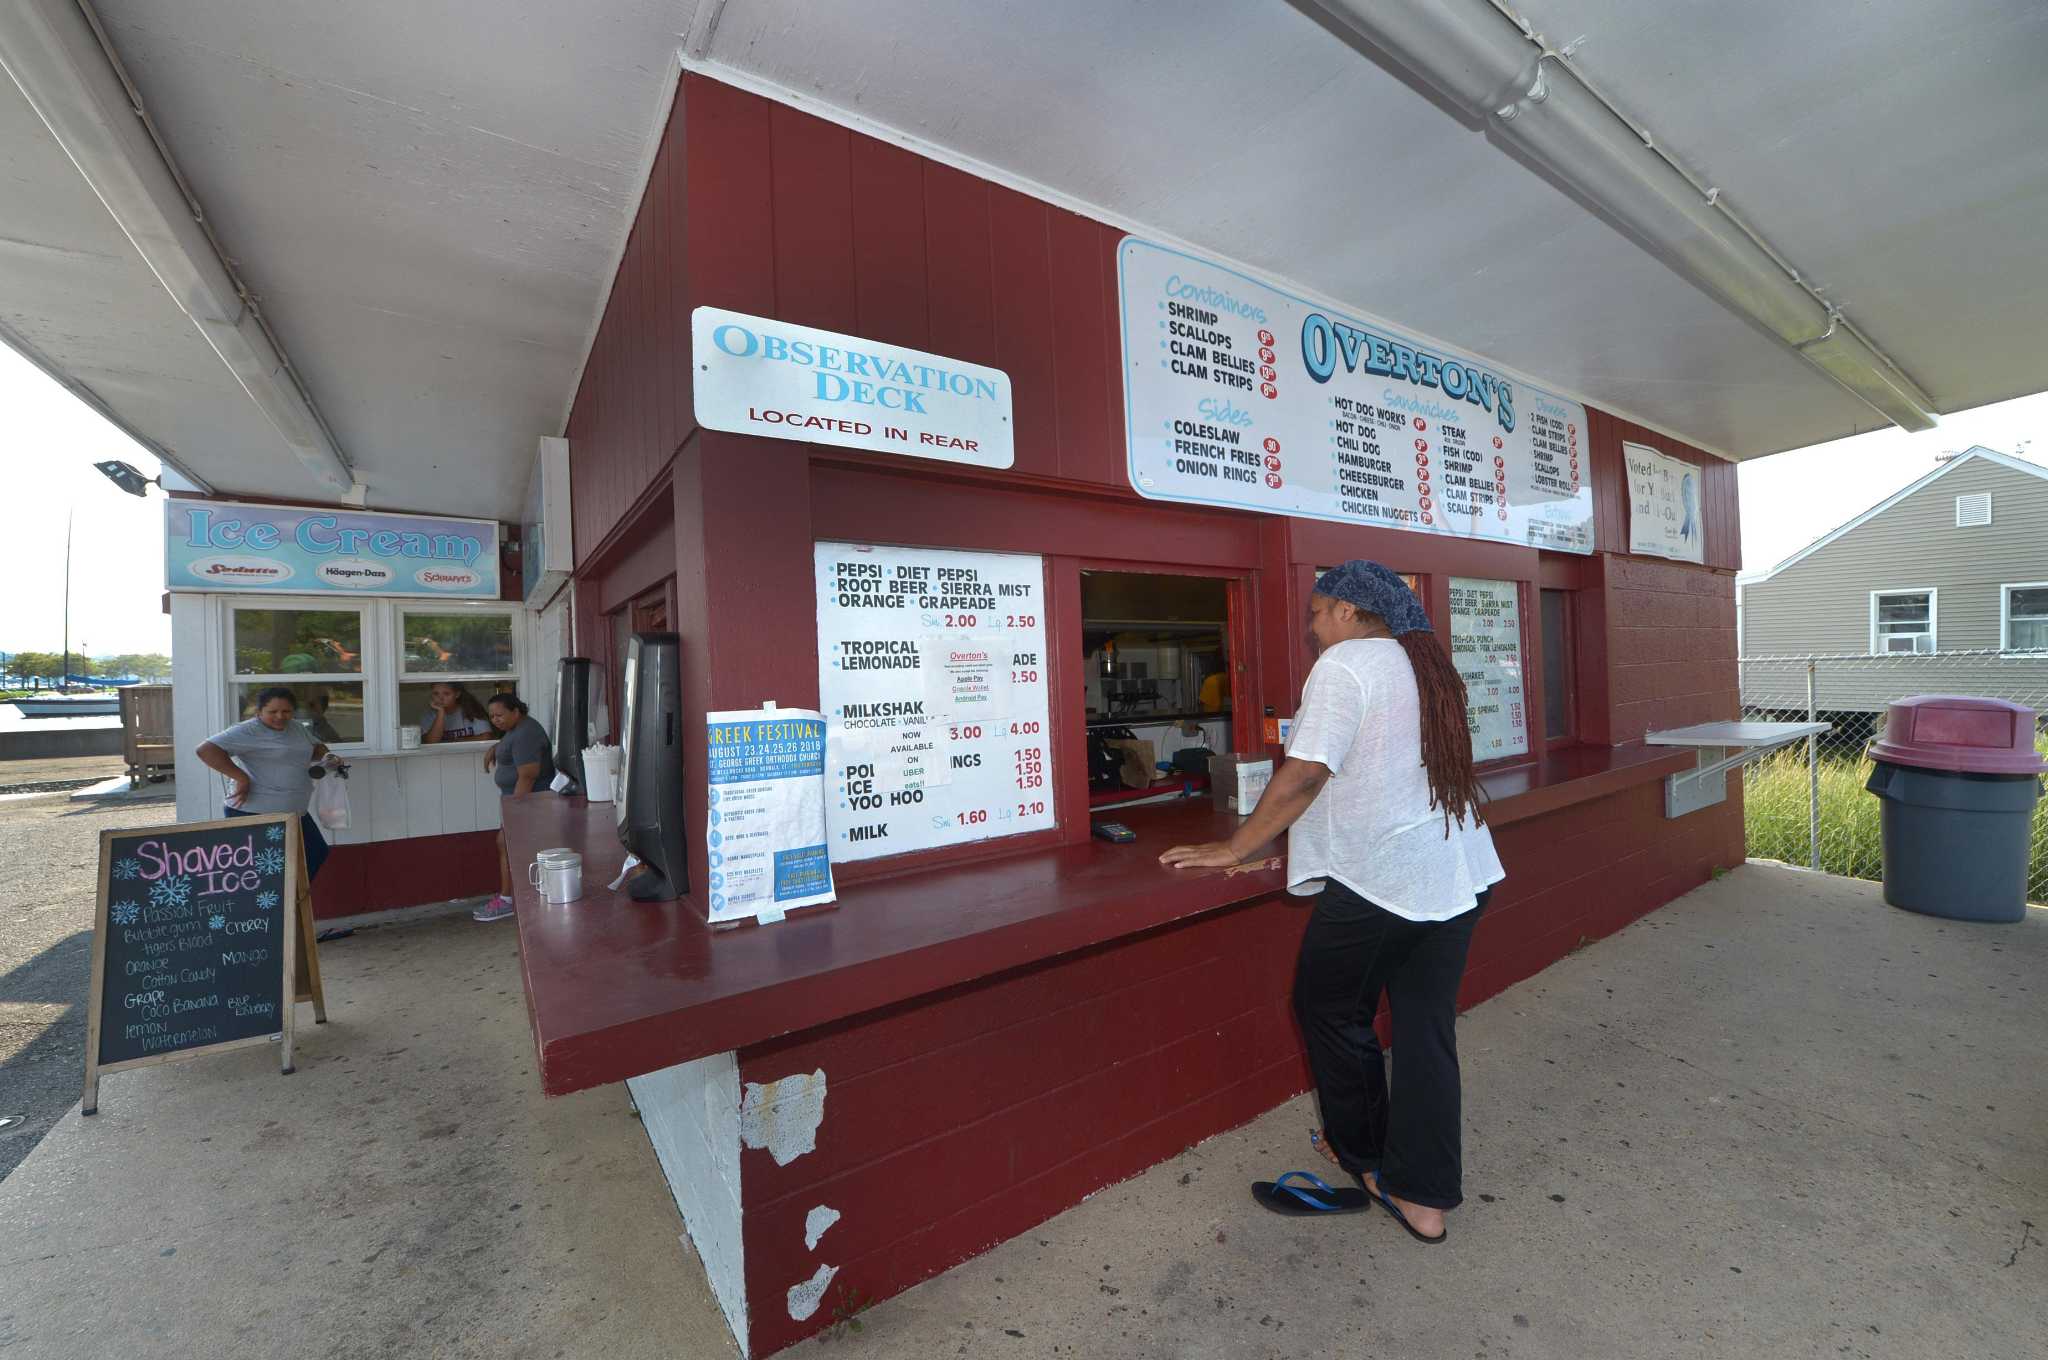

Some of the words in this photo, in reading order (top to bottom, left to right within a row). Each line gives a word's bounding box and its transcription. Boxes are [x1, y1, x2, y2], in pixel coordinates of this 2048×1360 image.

[1165, 275, 1267, 324] Containers
[1168, 302, 1218, 326] SHRIMP
[1169, 320, 1232, 349] SCALLOPS
[712, 325, 998, 400] OBSERVATION
[1170, 340, 1207, 361] CLAM
[1212, 350, 1255, 374] BELLIES
[1171, 360, 1208, 380] CLAM
[1213, 369, 1253, 391] STRIPS
[1302, 313, 1515, 433] OVERTON'S
[812, 371, 928, 414] DECK
[1198, 397, 1254, 427] Sides
[1335, 396, 1353, 411] HOT
[1356, 403, 1374, 417] DOG
[1377, 408, 1406, 425] WORKS
[749, 407, 871, 435] LOCATED
[884, 427, 908, 440] IN
[920, 432, 978, 452] REAR
[1174, 420, 1240, 444] COLESLAW
[1336, 420, 1354, 434] HOT
[1358, 425, 1376, 439] DOG
[1442, 425, 1466, 439] STEAK
[1532, 424, 1547, 437] CLAM
[1548, 430, 1565, 443] STRIPS
[1175, 439, 1225, 460] FRENCH
[1230, 448, 1261, 467] FRIES
[1337, 437, 1359, 451] CHILI
[1363, 441, 1380, 456] DOG
[1443, 446, 1460, 459] FISH
[1463, 449, 1483, 463] (COD)
[1533, 437, 1547, 449] CLAM
[1549, 442, 1567, 455] BELLIES
[1534, 449, 1553, 462] SHRIMP
[1176, 459, 1217, 478] ONION
[1223, 465, 1257, 483] RINGS
[1338, 452, 1391, 473] HAMBURGER
[1444, 460, 1473, 474] SHRIMP
[1535, 461, 1559, 476] SCALLOPS
[1628, 458, 1652, 476] Voted
[1339, 468, 1404, 491] CHEESEBURGER
[1445, 474, 1466, 487] CLAM
[1470, 479, 1494, 492] BELLIES
[1535, 473, 1557, 487] LOBSTER
[1559, 480, 1570, 491] ROLL
[1341, 484, 1378, 501] CHICKEN
[1446, 488, 1467, 500] CLAM
[1470, 492, 1494, 505] STRIPS
[1342, 501, 1379, 516] CHICKEN
[1382, 506, 1418, 522] NUGGETS
[1447, 502, 1483, 517] SCALLOPS
[186, 509, 281, 551] Ice
[295, 515, 481, 567] Cream
[837, 562, 882, 578] PEPSI
[897, 566, 930, 580] DIET
[937, 568, 978, 582] PEPSI
[837, 578, 882, 593] ROOT
[889, 580, 928, 594] BEER
[941, 583, 992, 596] SIERRA
[999, 584, 1031, 597] MIST
[838, 593, 905, 609] ORANGE
[919, 596, 996, 610] GRAPEADE
[945, 614, 976, 628] 2.00
[1006, 615, 1036, 628] 2.50
[841, 641, 918, 655] TROPICAL
[950, 651, 988, 660] Overton's
[841, 656, 920, 670] LEMONADE
[1011, 671, 1038, 684] 2.50
[843, 701, 924, 718] MILKSHAK
[843, 717, 896, 729] CHOCOLATE
[950, 726, 981, 740] 3.00
[1010, 721, 1040, 735] 4.00
[708, 725, 752, 744] GREEK
[758, 722, 820, 741] FESTIVAL
[902, 731, 920, 740] NOW
[709, 746, 740, 759] AUGUST
[801, 741, 820, 752] 2018
[890, 742, 934, 753] AVAILABLE
[1014, 748, 1041, 762] 1.50
[718, 758, 743, 769] GEORGE
[745, 757, 763, 767] GREEK
[765, 753, 797, 764] ORTHODOX
[907, 756, 918, 764] ON
[1015, 762, 1042, 776] 1.50
[903, 768, 924, 777] UBER
[847, 780, 873, 795] ICE
[1016, 775, 1043, 790] 1.50
[849, 794, 883, 811] YOO
[890, 789, 924, 806] HOO
[957, 810, 987, 826] 1.60
[1018, 801, 1044, 816] 2.10
[849, 823, 888, 842] MILK
[137, 835, 256, 880] Shaved
[197, 870, 261, 896] Ice
